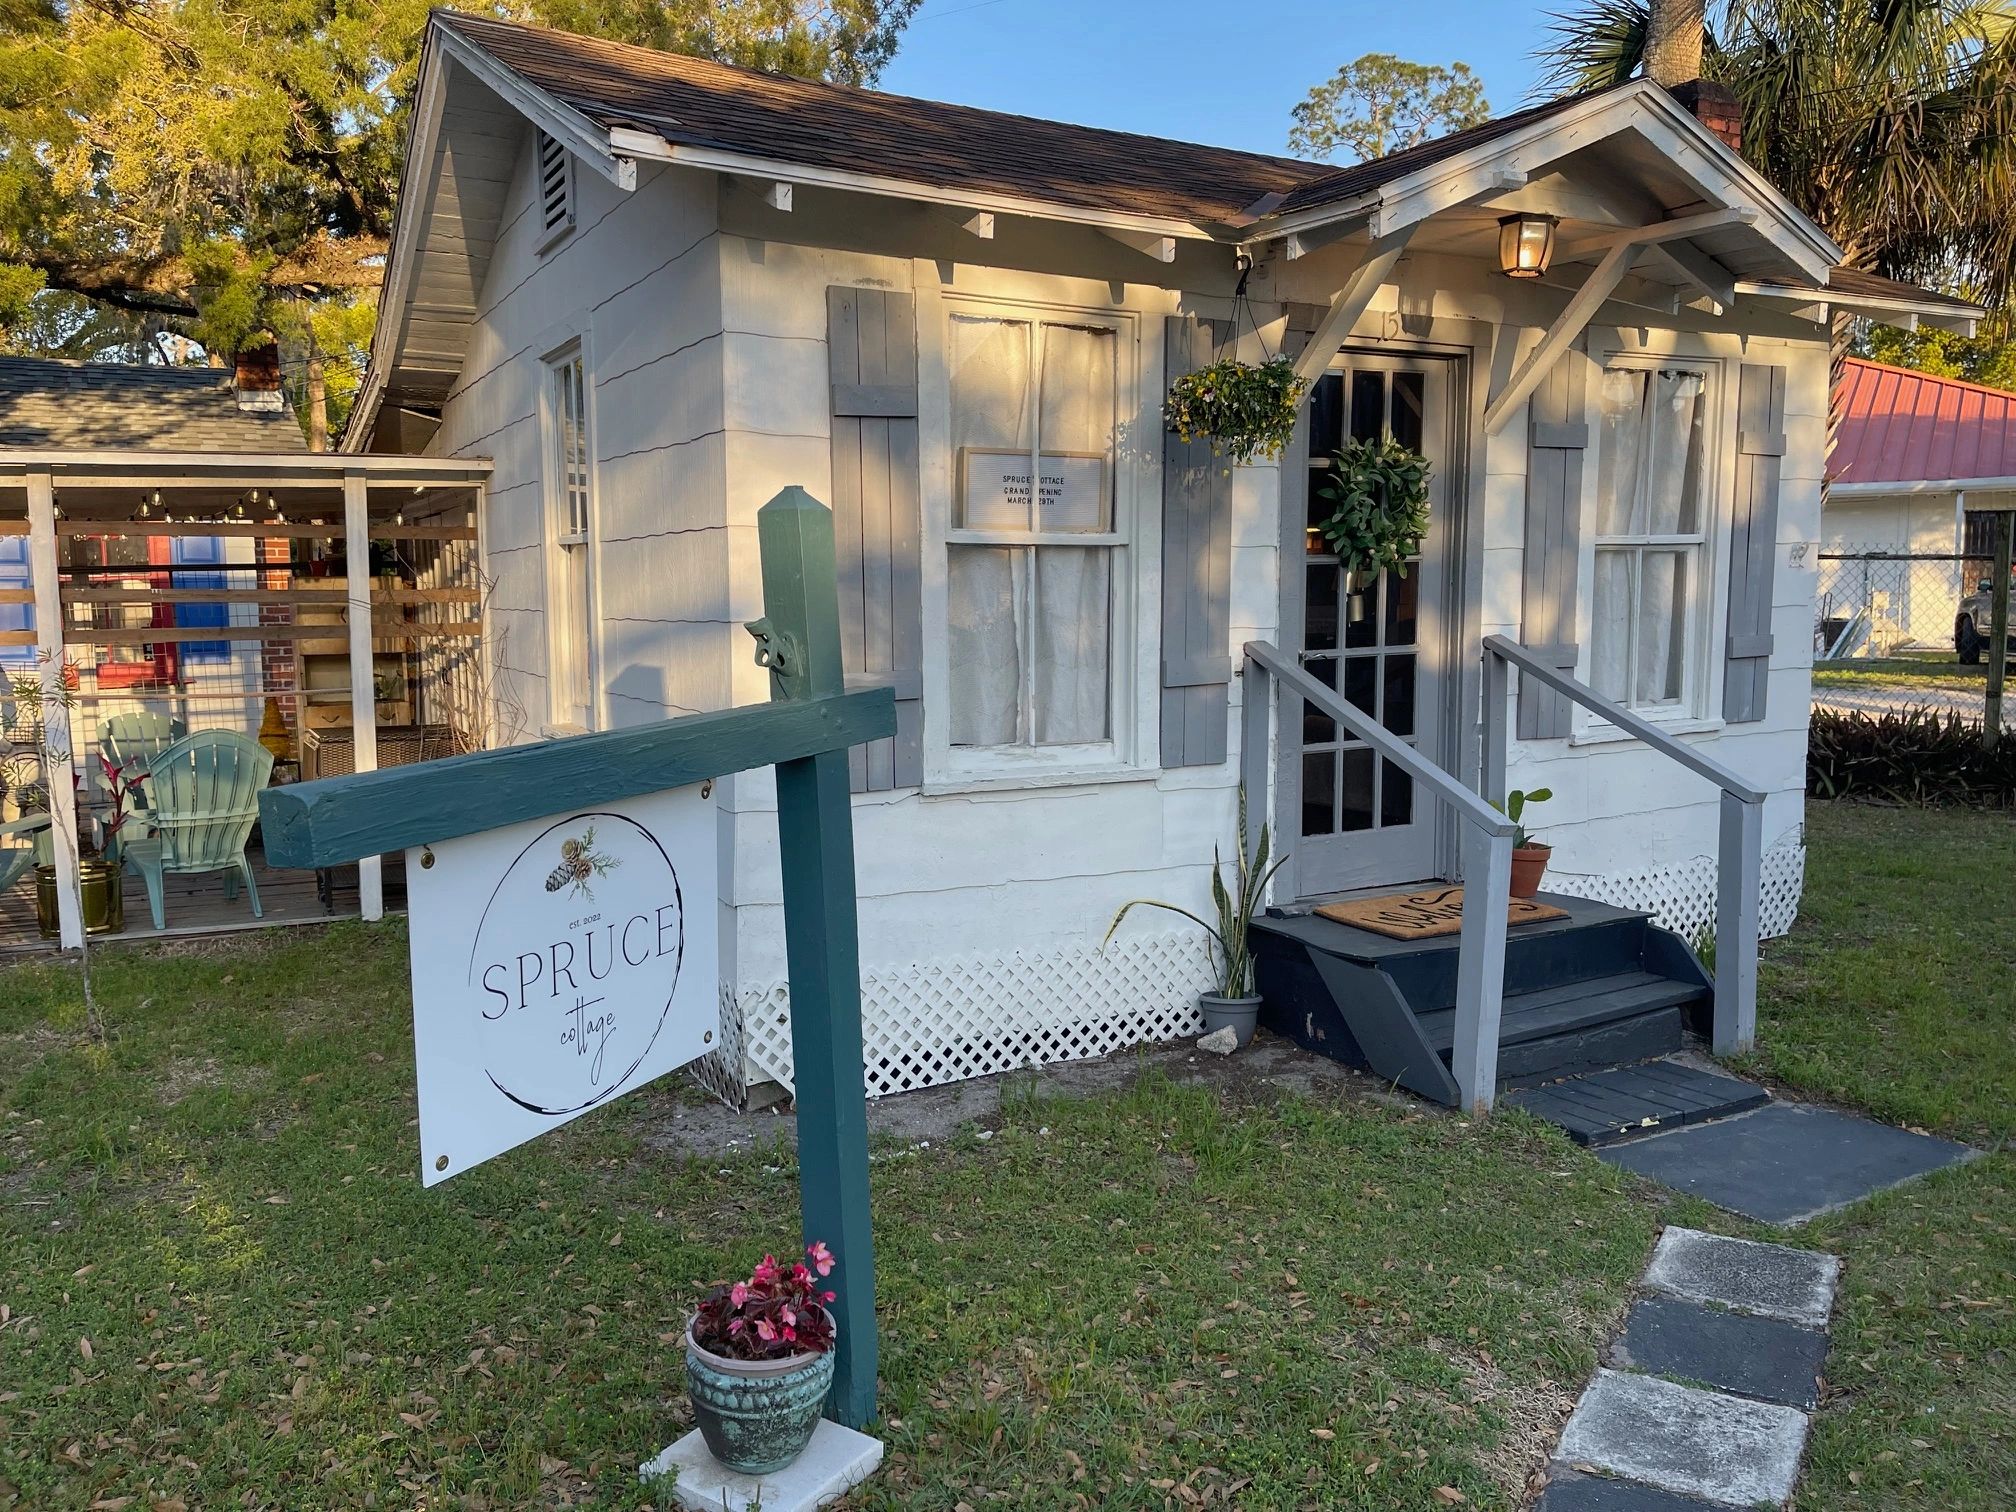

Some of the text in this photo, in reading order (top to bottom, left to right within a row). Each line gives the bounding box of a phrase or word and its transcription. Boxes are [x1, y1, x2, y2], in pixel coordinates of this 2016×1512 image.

[1380, 310, 1399, 340] 15
[1003, 475, 1064, 485] SPRUCE OTTAGE
[1004, 487, 1062, 496] GRAND PENING
[1007, 496, 1032, 505] MARCH
[569, 912, 602, 930] est. 2022
[481, 903, 677, 1021] SPRUCE
[559, 995, 617, 1086] cottage
